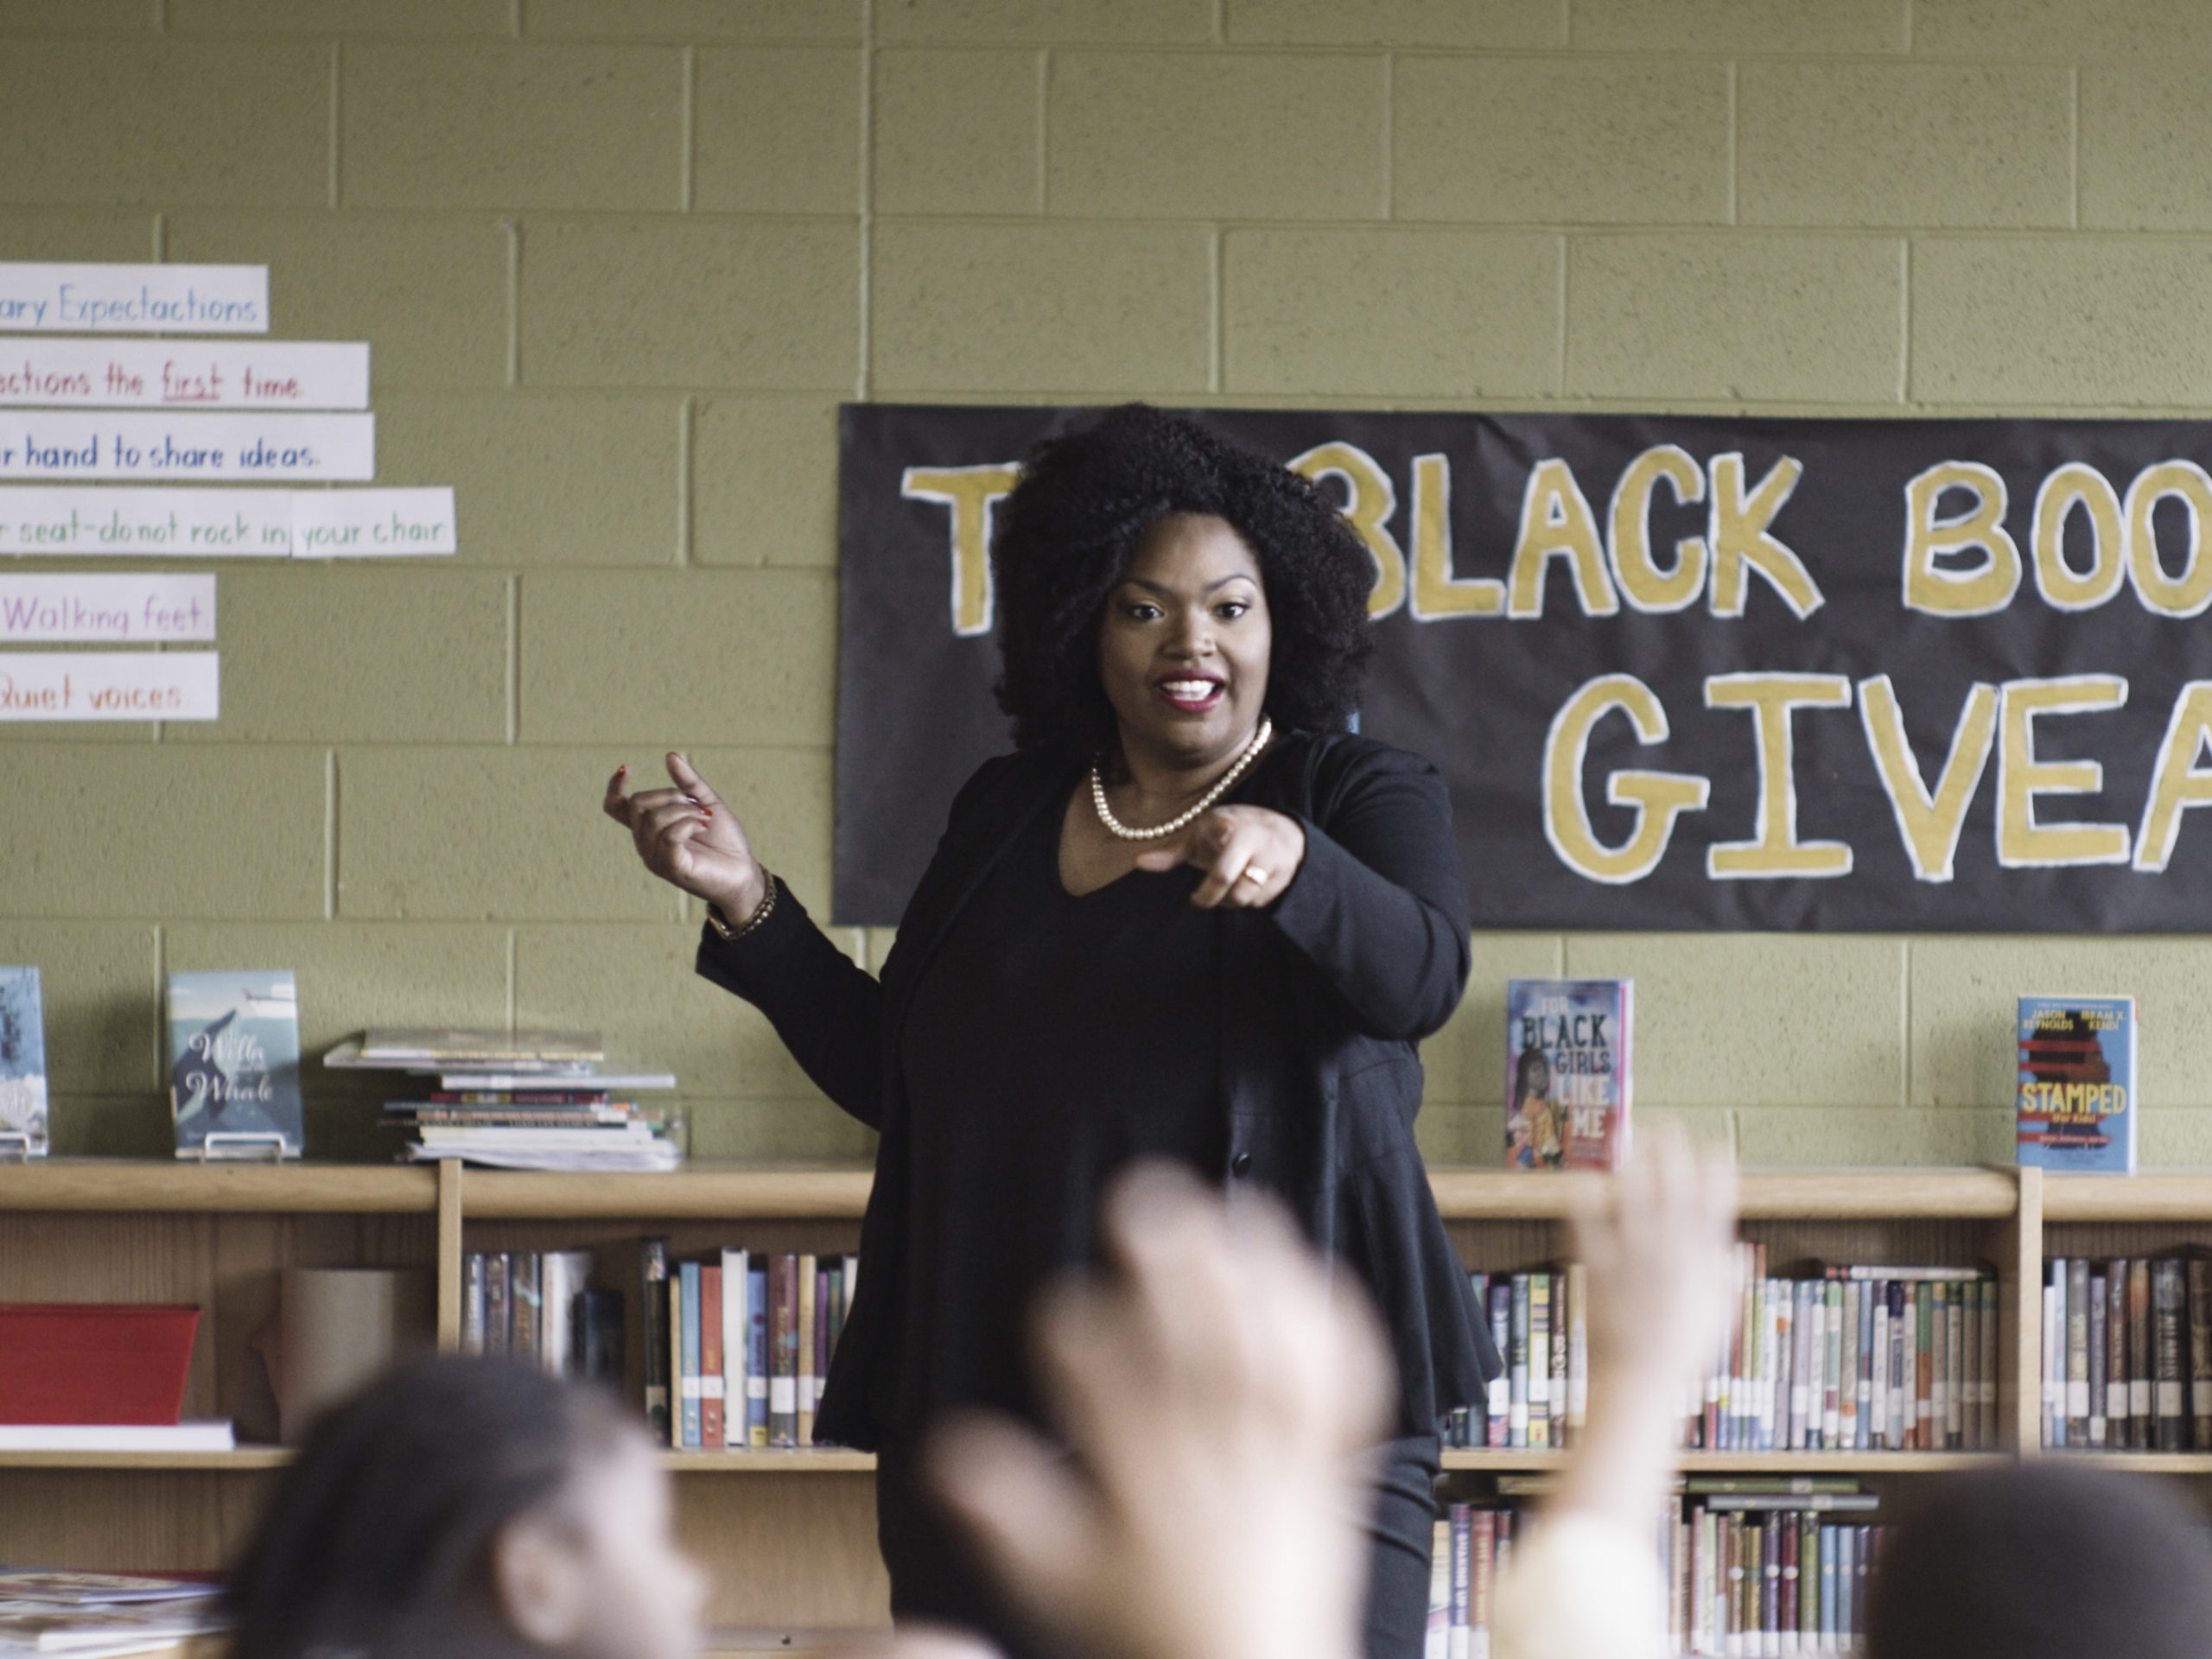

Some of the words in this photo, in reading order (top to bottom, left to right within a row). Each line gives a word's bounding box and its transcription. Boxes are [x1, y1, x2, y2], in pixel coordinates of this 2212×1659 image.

[59, 283, 258, 326] Expectactions
[105, 361, 143, 395] the
[162, 359, 224, 397] first
[26, 434, 98, 467] hand
[114, 434, 141, 467] to
[149, 434, 224, 468] share
[190, 511, 249, 545] rock
[262, 522, 285, 545] in
[302, 524, 361, 550] your
[1284, 440, 1826, 621] BLACK
[3, 595, 130, 636] Walking
[1522, 1014, 1608, 1049] BLACK
[1556, 1052, 1611, 1074] GIRLS
[1558, 1076, 1610, 1106] LIKE
[2021, 1083, 2126, 1115] STAMPED
[1572, 1107, 1606, 1138] ME
